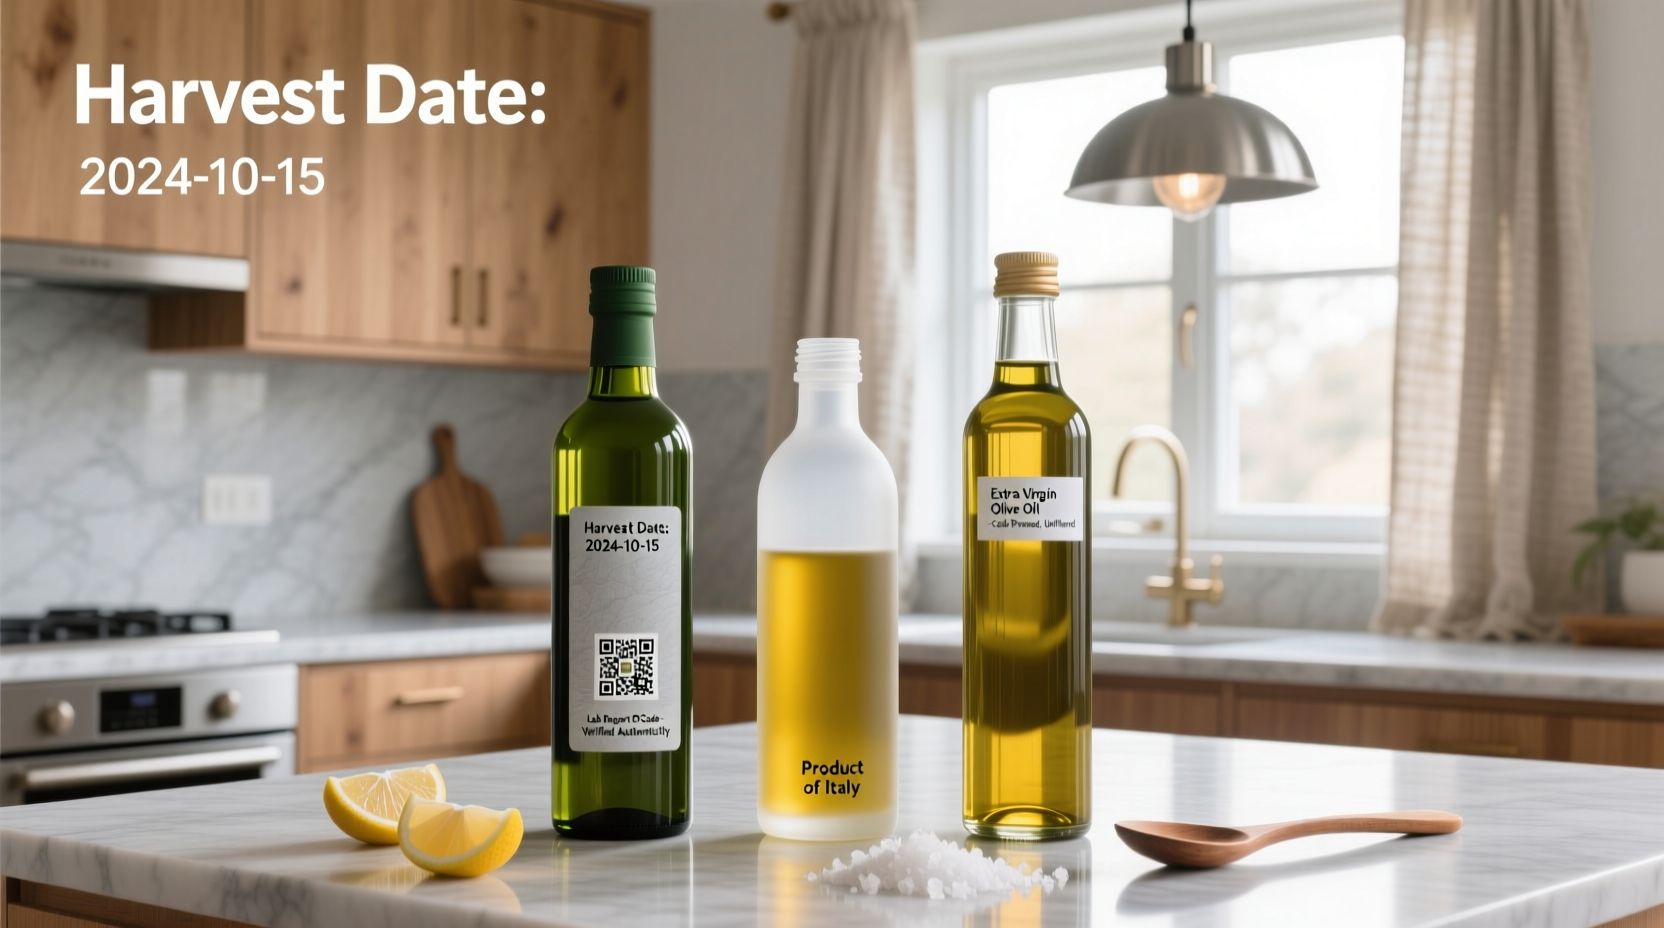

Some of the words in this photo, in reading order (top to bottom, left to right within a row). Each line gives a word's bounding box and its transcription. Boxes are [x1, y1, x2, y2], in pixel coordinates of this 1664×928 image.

[991, 487, 1020, 500] Extra
[1023, 487, 1057, 502] Virgin
[990, 502, 1020, 515] Olive
[1023, 502, 1040, 515] Oil
[584, 521, 634, 534] Harvest
[637, 521, 669, 534] Date:
[585, 539, 659, 552] 2024-10-15
[802, 759, 864, 775] Product
[803, 779, 821, 794] of
[825, 779, 861, 798] Italy
